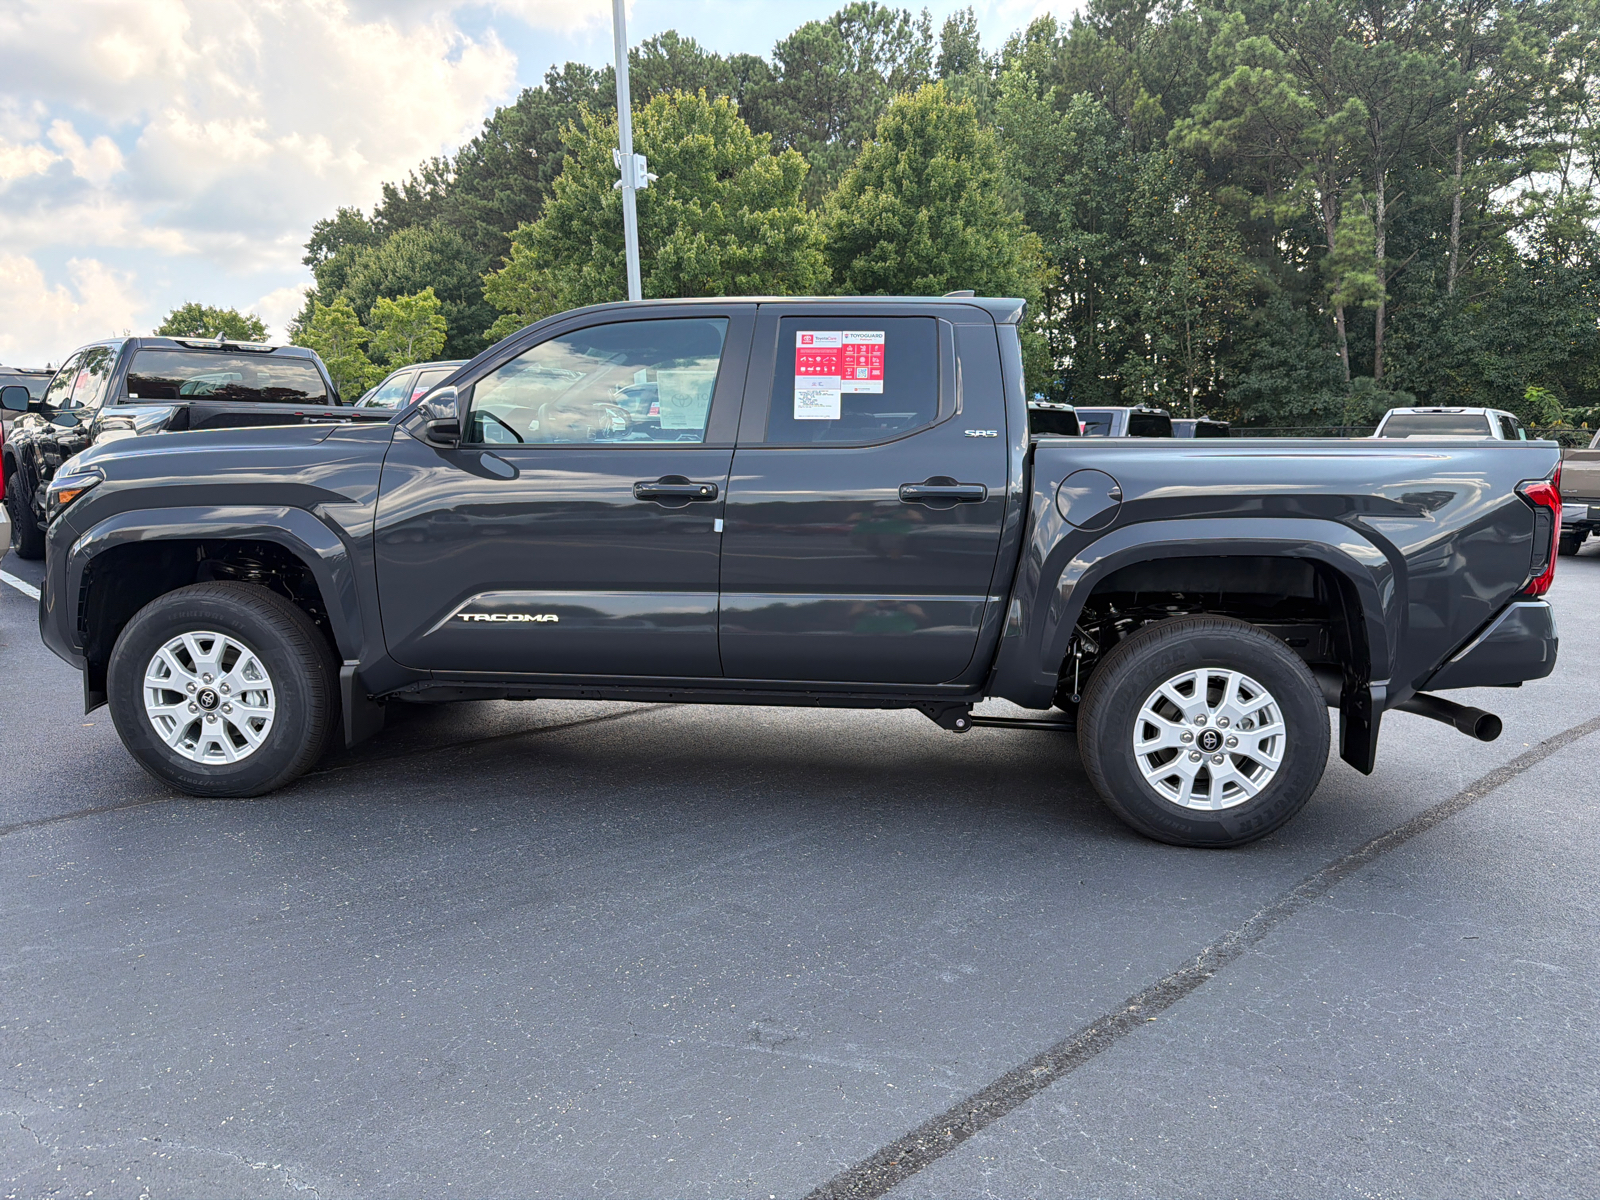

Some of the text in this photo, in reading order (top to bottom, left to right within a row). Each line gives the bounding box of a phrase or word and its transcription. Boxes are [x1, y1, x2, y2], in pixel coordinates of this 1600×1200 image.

[964, 430, 998, 438] SR5
[457, 614, 559, 622] TACOMA
[1240, 752, 1313, 834] RANGLER
